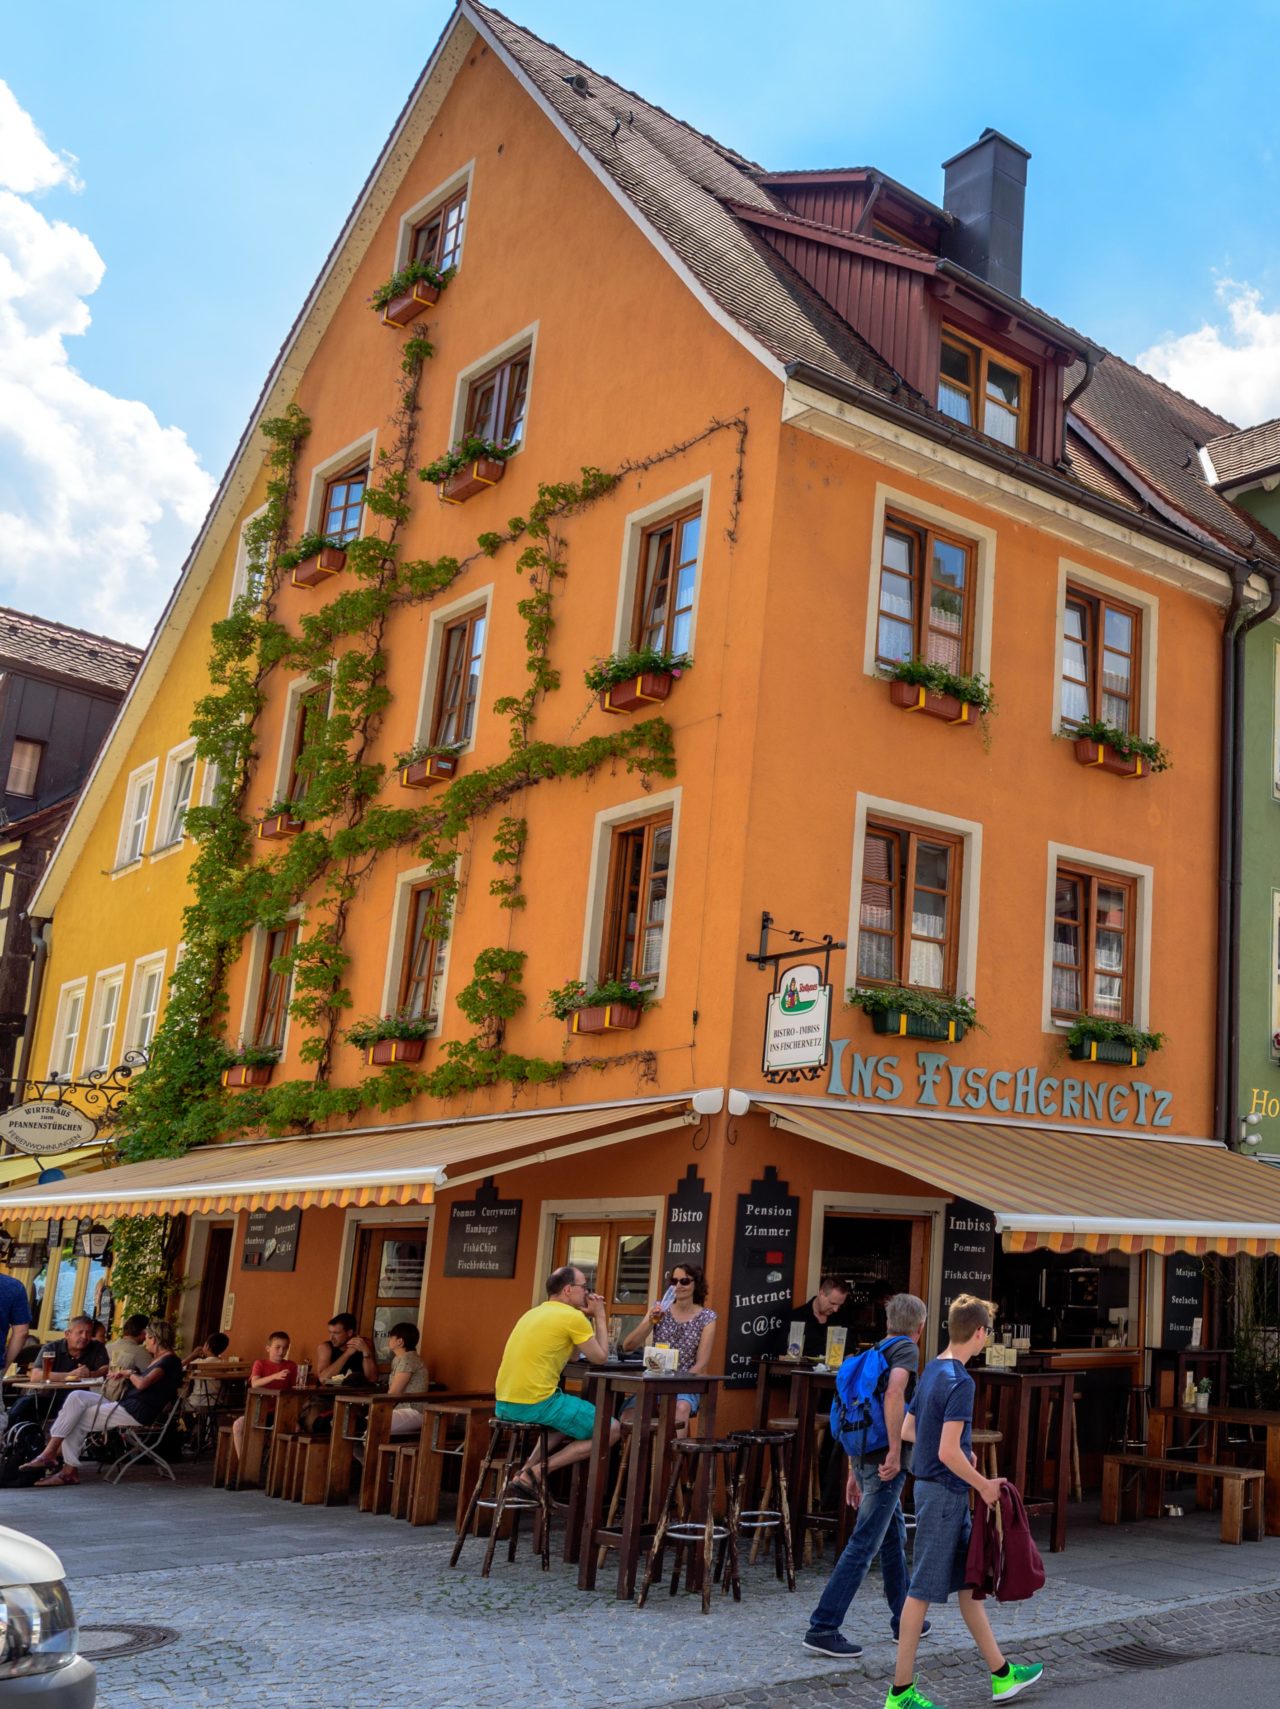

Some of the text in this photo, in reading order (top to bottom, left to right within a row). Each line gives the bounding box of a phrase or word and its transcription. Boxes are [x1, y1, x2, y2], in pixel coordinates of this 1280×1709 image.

[774, 1028, 795, 1038] BISTRO
[800, 1024, 820, 1035] IMBISS
[770, 1038, 822, 1052] INS FISCHERNETZ
[24, 1106, 72, 1118] WIRTSHAUS
[9, 1120, 83, 1131] PFANNENSTÜBCHEN
[8, 1130, 82, 1151] FERIENWOHNUNGEN
[452, 1207, 517, 1218] Pommes Currywurst
[671, 1207, 703, 1222] Bistro
[746, 1204, 792, 1217] Pension
[275, 1223, 296, 1235] Internet
[465, 1224, 498, 1236] Hamburger
[950, 1216, 991, 1232] Imbiss
[744, 1225, 791, 1237] Zimmer
[463, 1243, 497, 1254] Fish&Chips
[668, 1238, 701, 1253] Imbiss
[953, 1243, 986, 1253] Pommes
[944, 1270, 991, 1282] Fish&Chips
[735, 1288, 792, 1308] Internet
[1171, 1295, 1198, 1305] Seelachs
[741, 1315, 783, 1337] C@fe
[1169, 1323, 1192, 1332] Bismar
[731, 1354, 751, 1367] Cup
[731, 1372, 758, 1380] Coffee
